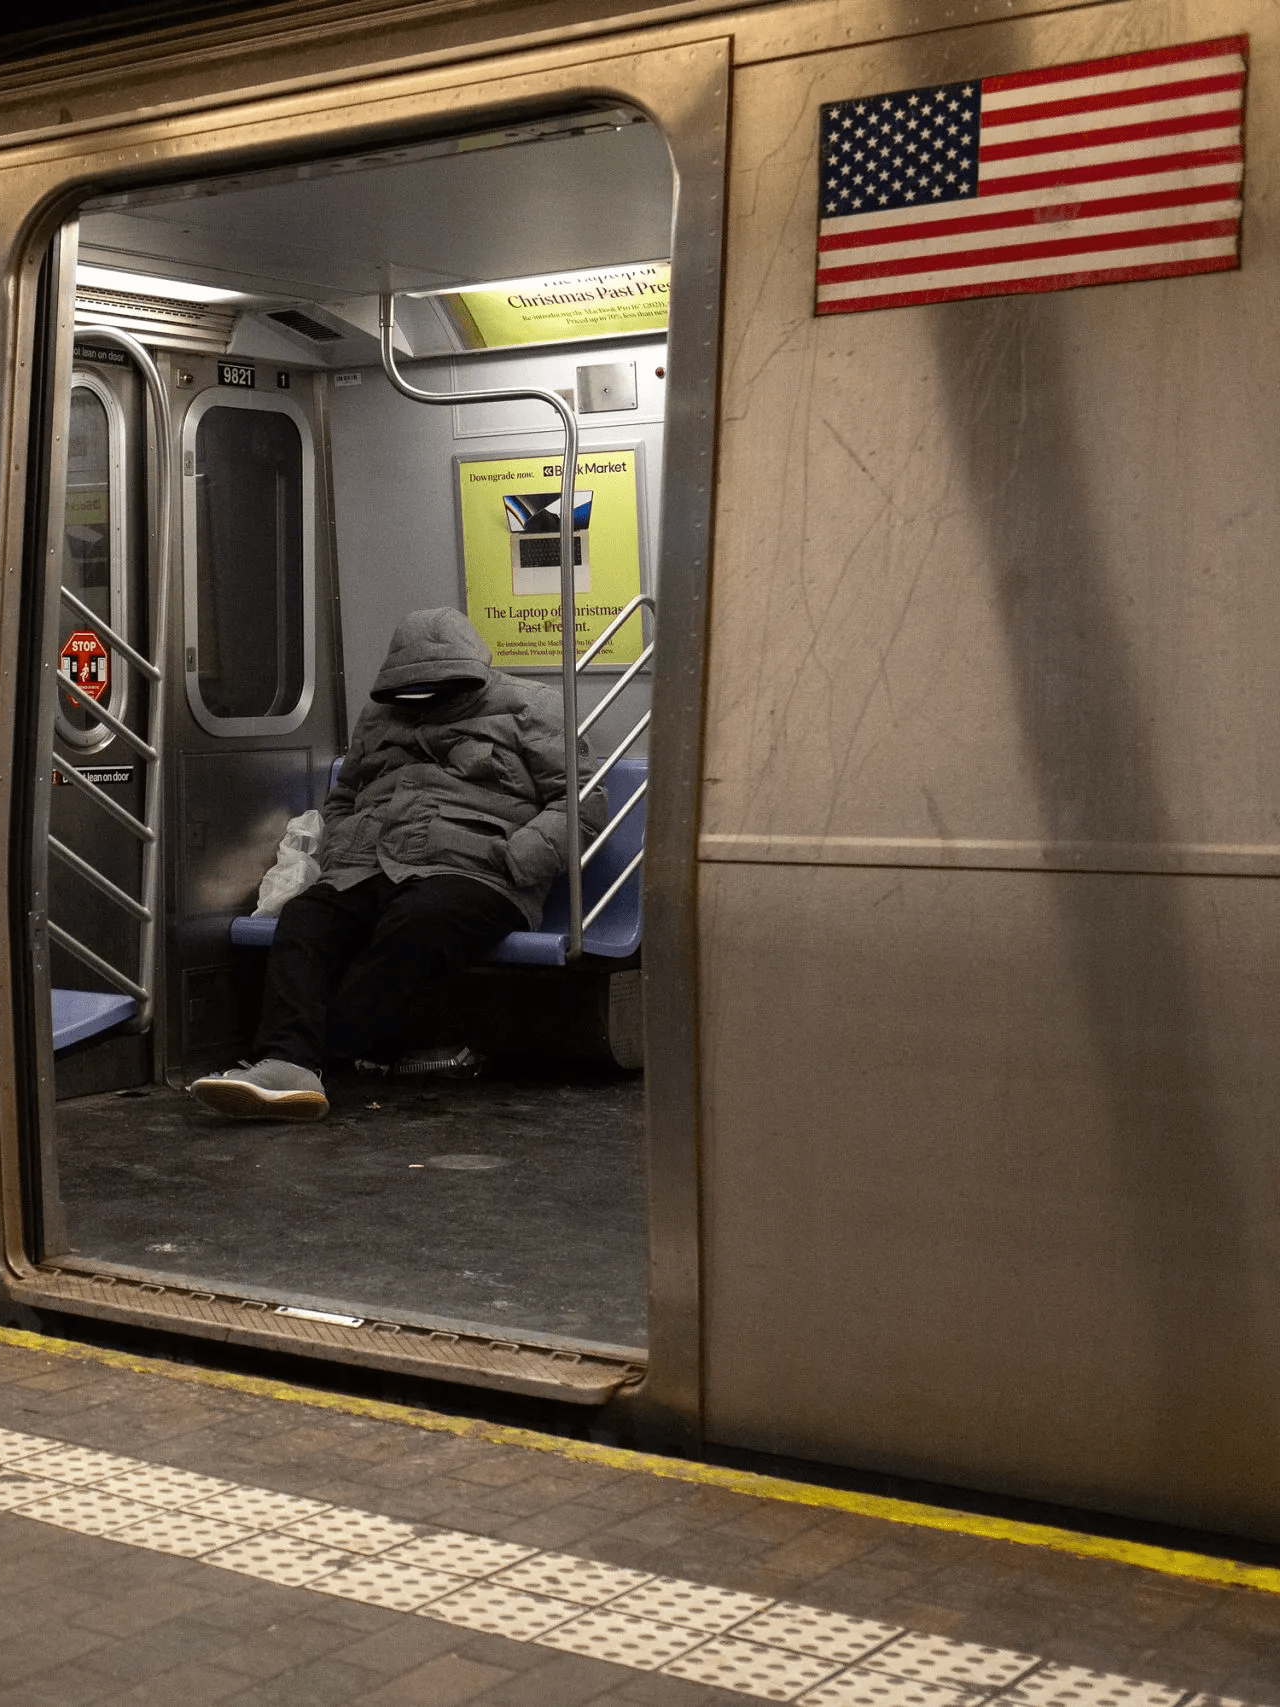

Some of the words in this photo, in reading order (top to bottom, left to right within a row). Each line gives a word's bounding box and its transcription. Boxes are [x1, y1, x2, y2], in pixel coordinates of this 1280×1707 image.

[507, 288, 595, 309] Christmas
[596, 283, 635, 300] Past
[636, 280, 671, 296] Pres
[82, 347, 97, 358] lean
[97, 350, 108, 360] on
[108, 351, 125, 362] door
[223, 366, 252, 386] 9821
[280, 373, 286, 387] 1
[555, 463, 584, 476] Bk
[585, 461, 627, 474] Market
[469, 471, 516, 483] Downgrade
[516, 471, 535, 480] now.
[484, 607, 507, 618] The
[508, 606, 548, 620] Laptop
[550, 605, 562, 617] of
[517, 621, 541, 633] Past
[544, 620, 590, 633] Prent.
[71, 640, 97, 652] STOP
[87, 770, 103, 783] lean
[103, 773, 114, 782] on
[113, 770, 130, 782] door
